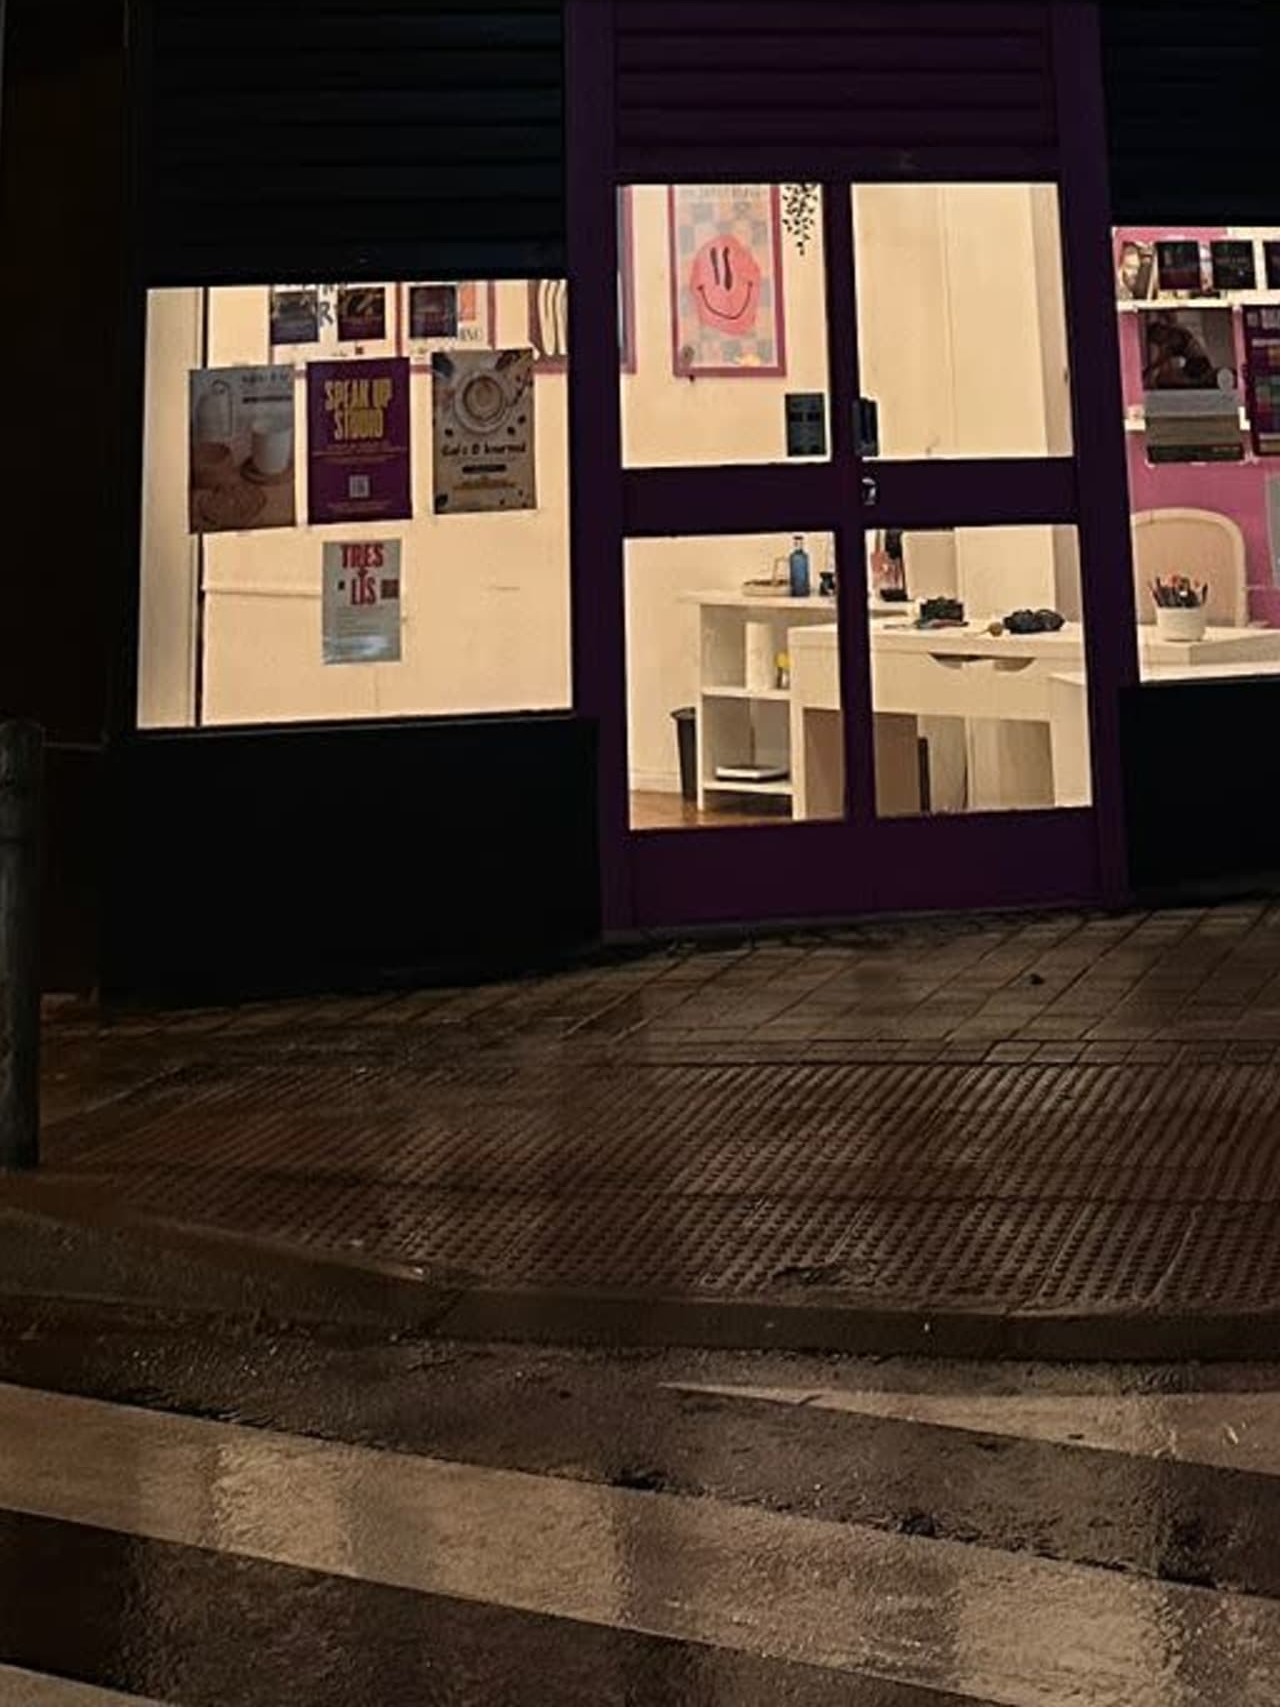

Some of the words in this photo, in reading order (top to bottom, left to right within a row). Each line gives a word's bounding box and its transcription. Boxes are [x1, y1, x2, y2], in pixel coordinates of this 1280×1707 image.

[324, 379, 369, 411] SPEAK
[372, 377, 393, 410] UP
[341, 543, 384, 568] TRES
